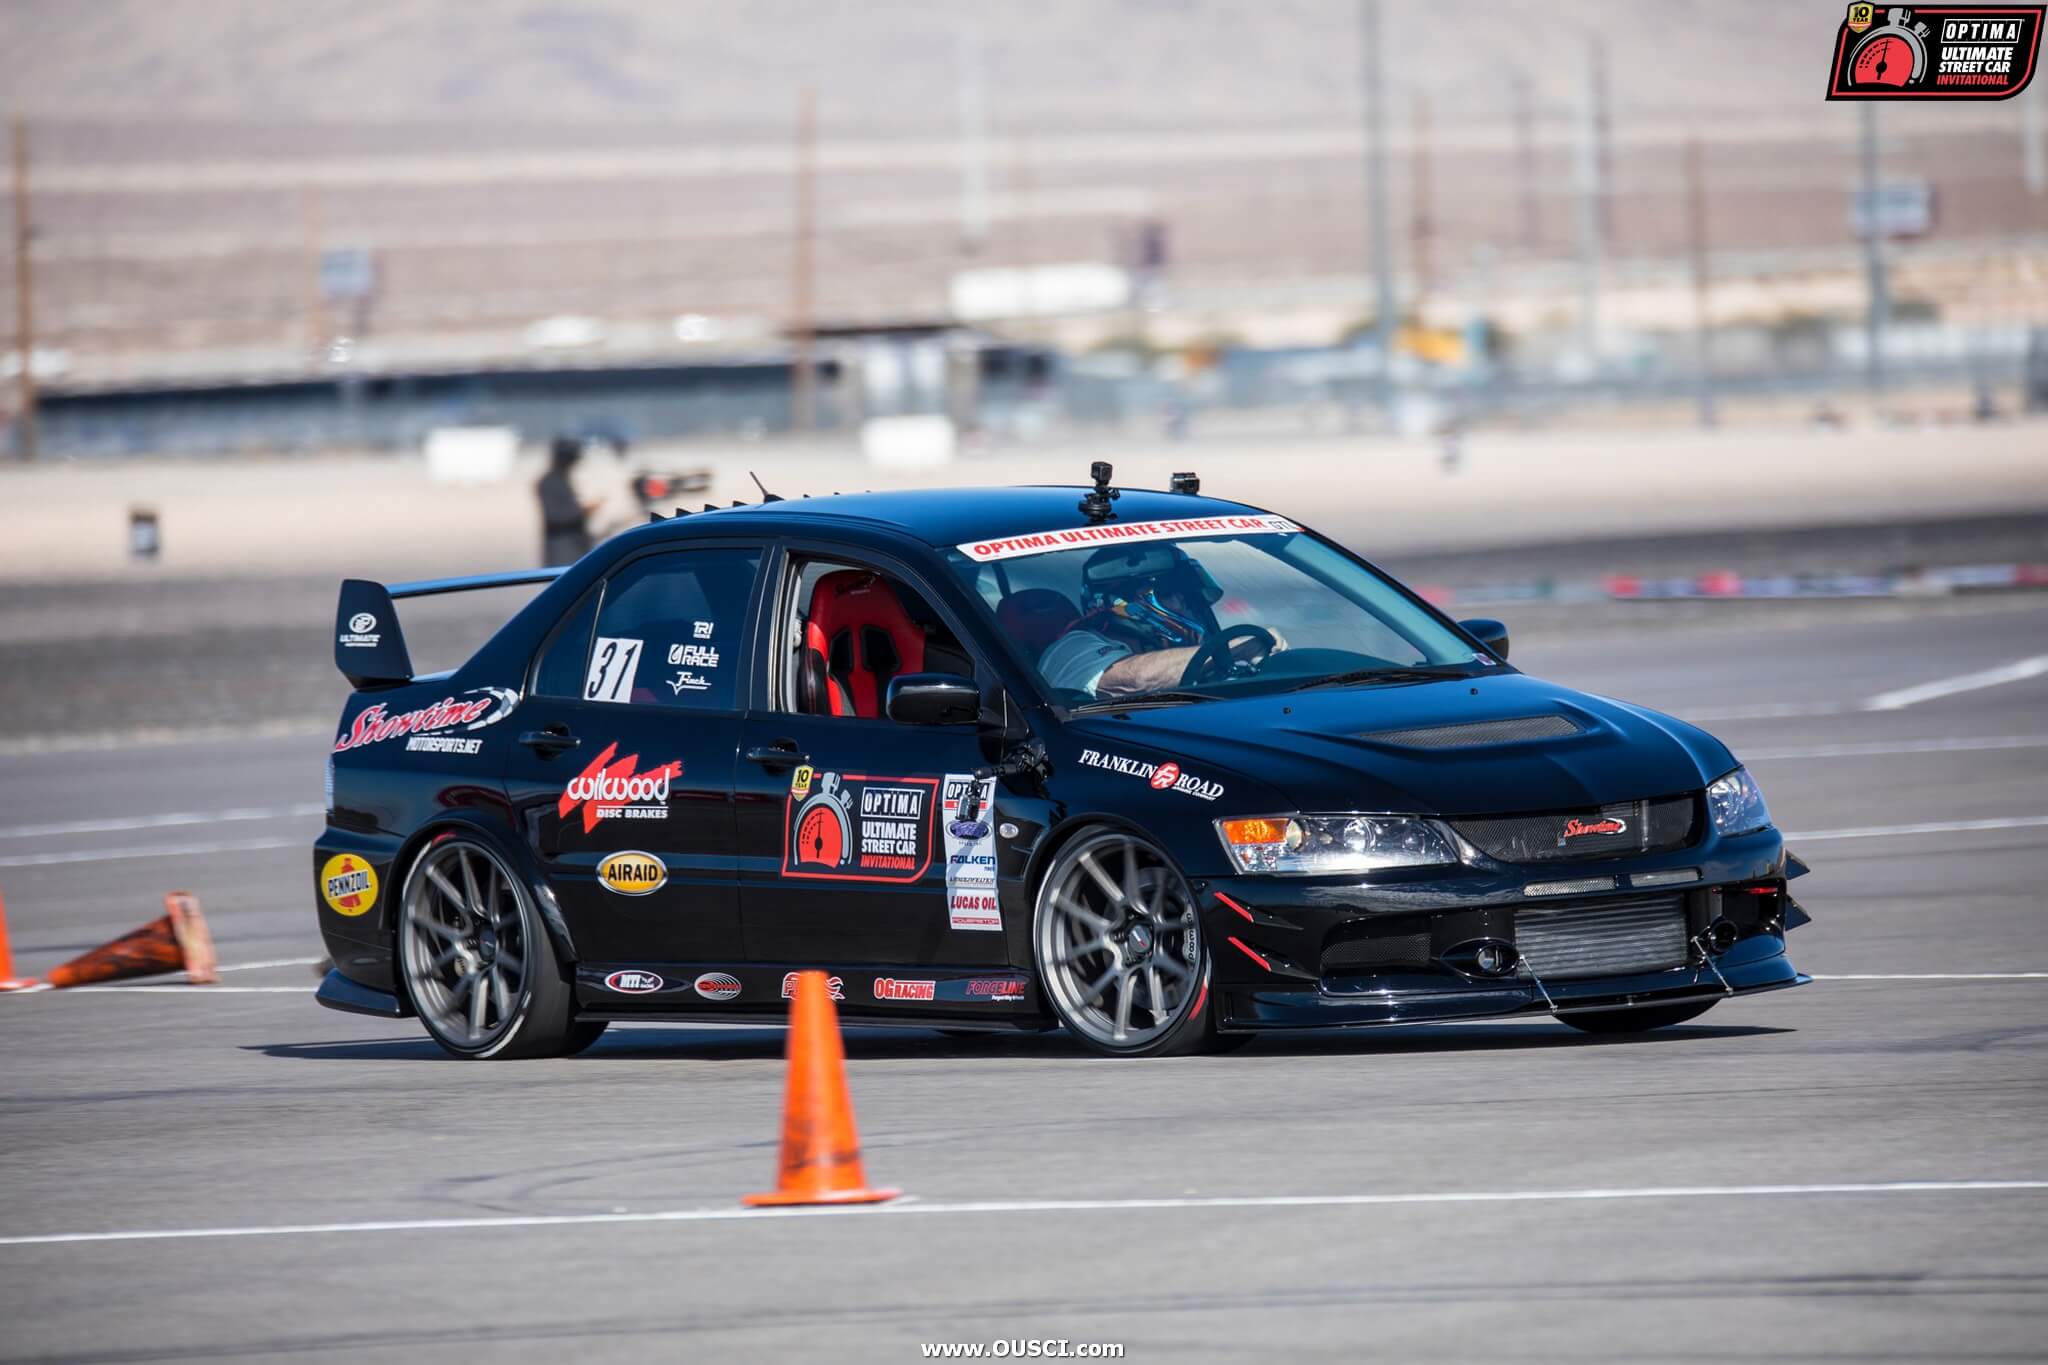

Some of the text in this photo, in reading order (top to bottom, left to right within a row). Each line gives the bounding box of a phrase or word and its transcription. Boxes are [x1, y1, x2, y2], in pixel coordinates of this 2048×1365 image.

[973, 517, 1268, 557] OPTIMA ULTIMATE STREET CAR
[683, 645, 720, 657] FULL
[588, 641, 637, 699] 31
[681, 655, 720, 668] RACE
[333, 696, 493, 753] Showtime
[405, 735, 483, 755] MOTORSPORTS.NET
[796, 769, 810, 783] 10
[1078, 749, 1159, 779] FRANKLIN
[1174, 773, 1225, 798] ROAD
[566, 768, 671, 801] wilwood
[947, 782, 989, 800] OPTA
[864, 792, 919, 815] OPTIMA
[596, 808, 668, 819] DISC BRAKES
[861, 820, 917, 841] ULTIMATE
[861, 838, 916, 855] STREET CAR
[860, 854, 916, 871] INVITATIONAL
[950, 854, 996, 865] FALKEN
[607, 863, 658, 882] AIRAID
[328, 871, 370, 897] PENNZOIL
[951, 895, 997, 911] LUCAS OIL
[874, 977, 934, 1000] OG RACING
[965, 980, 1025, 996] FORGELINE
